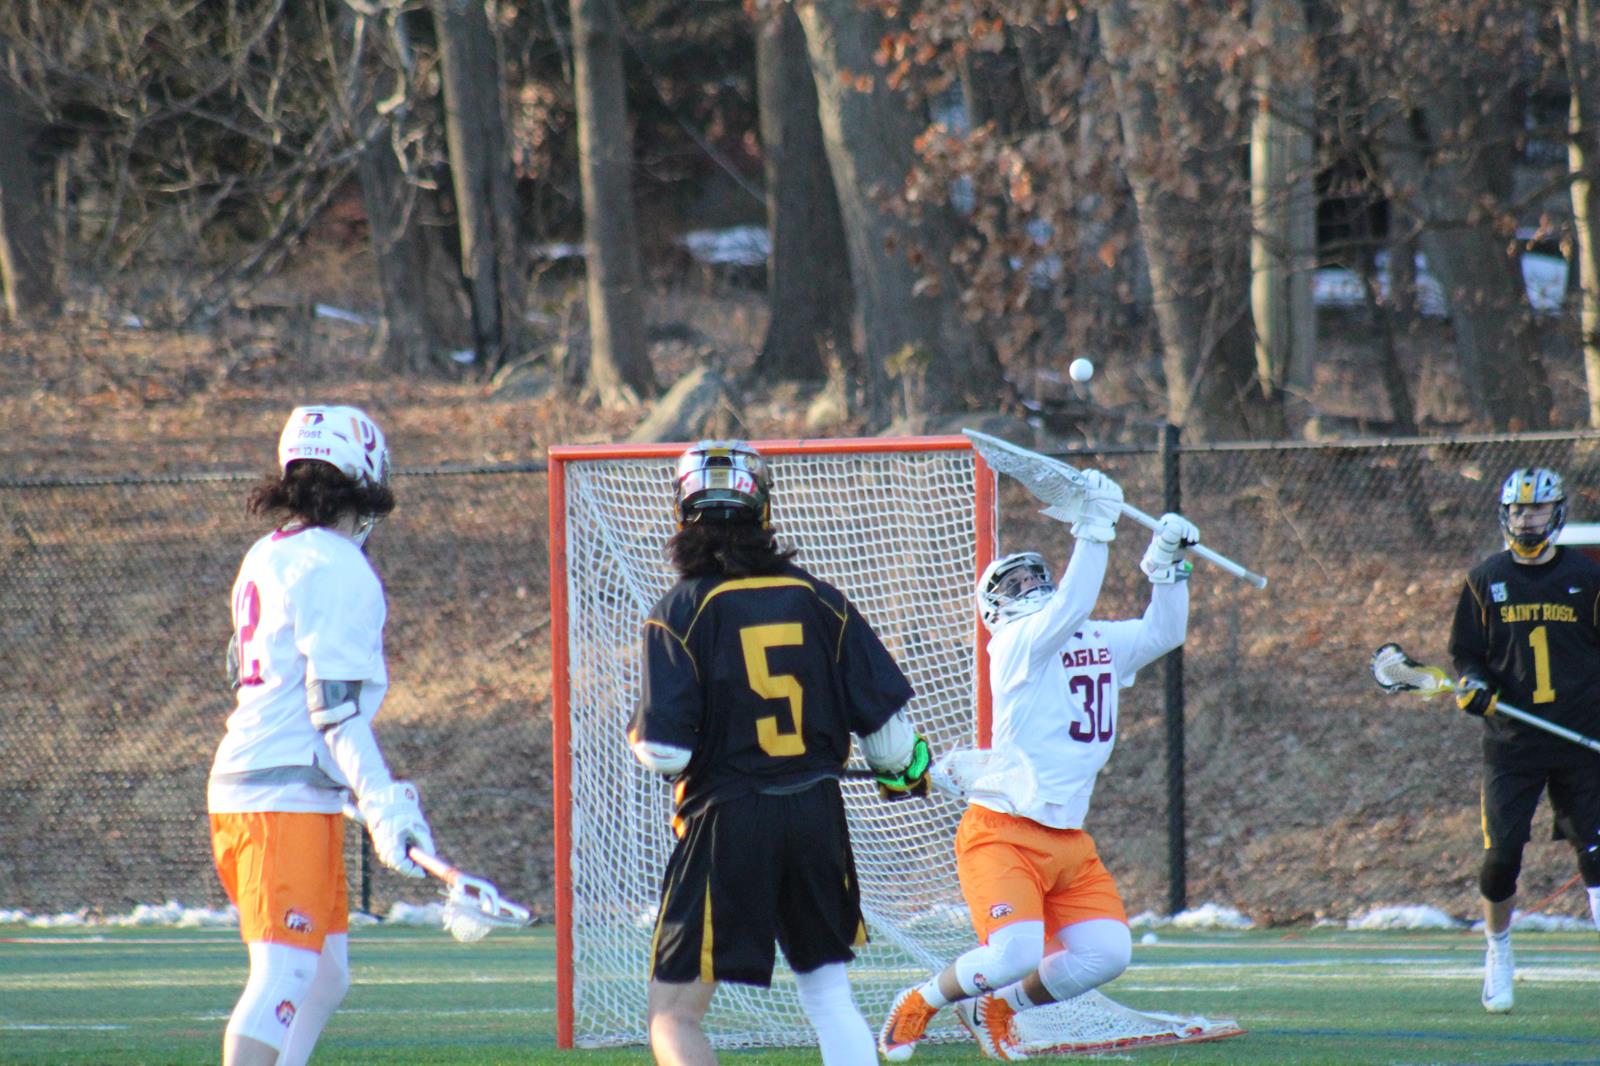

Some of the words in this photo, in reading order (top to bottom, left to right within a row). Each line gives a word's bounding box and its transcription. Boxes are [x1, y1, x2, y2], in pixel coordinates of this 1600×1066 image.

[298, 429, 321, 439] Post
[235, 580, 265, 687] 2
[1500, 604, 1540, 622] SAINT
[739, 622, 806, 757] 5
[1060, 647, 1112, 668] AGLE
[1528, 625, 1556, 704] 1
[1068, 673, 1113, 743] 30
